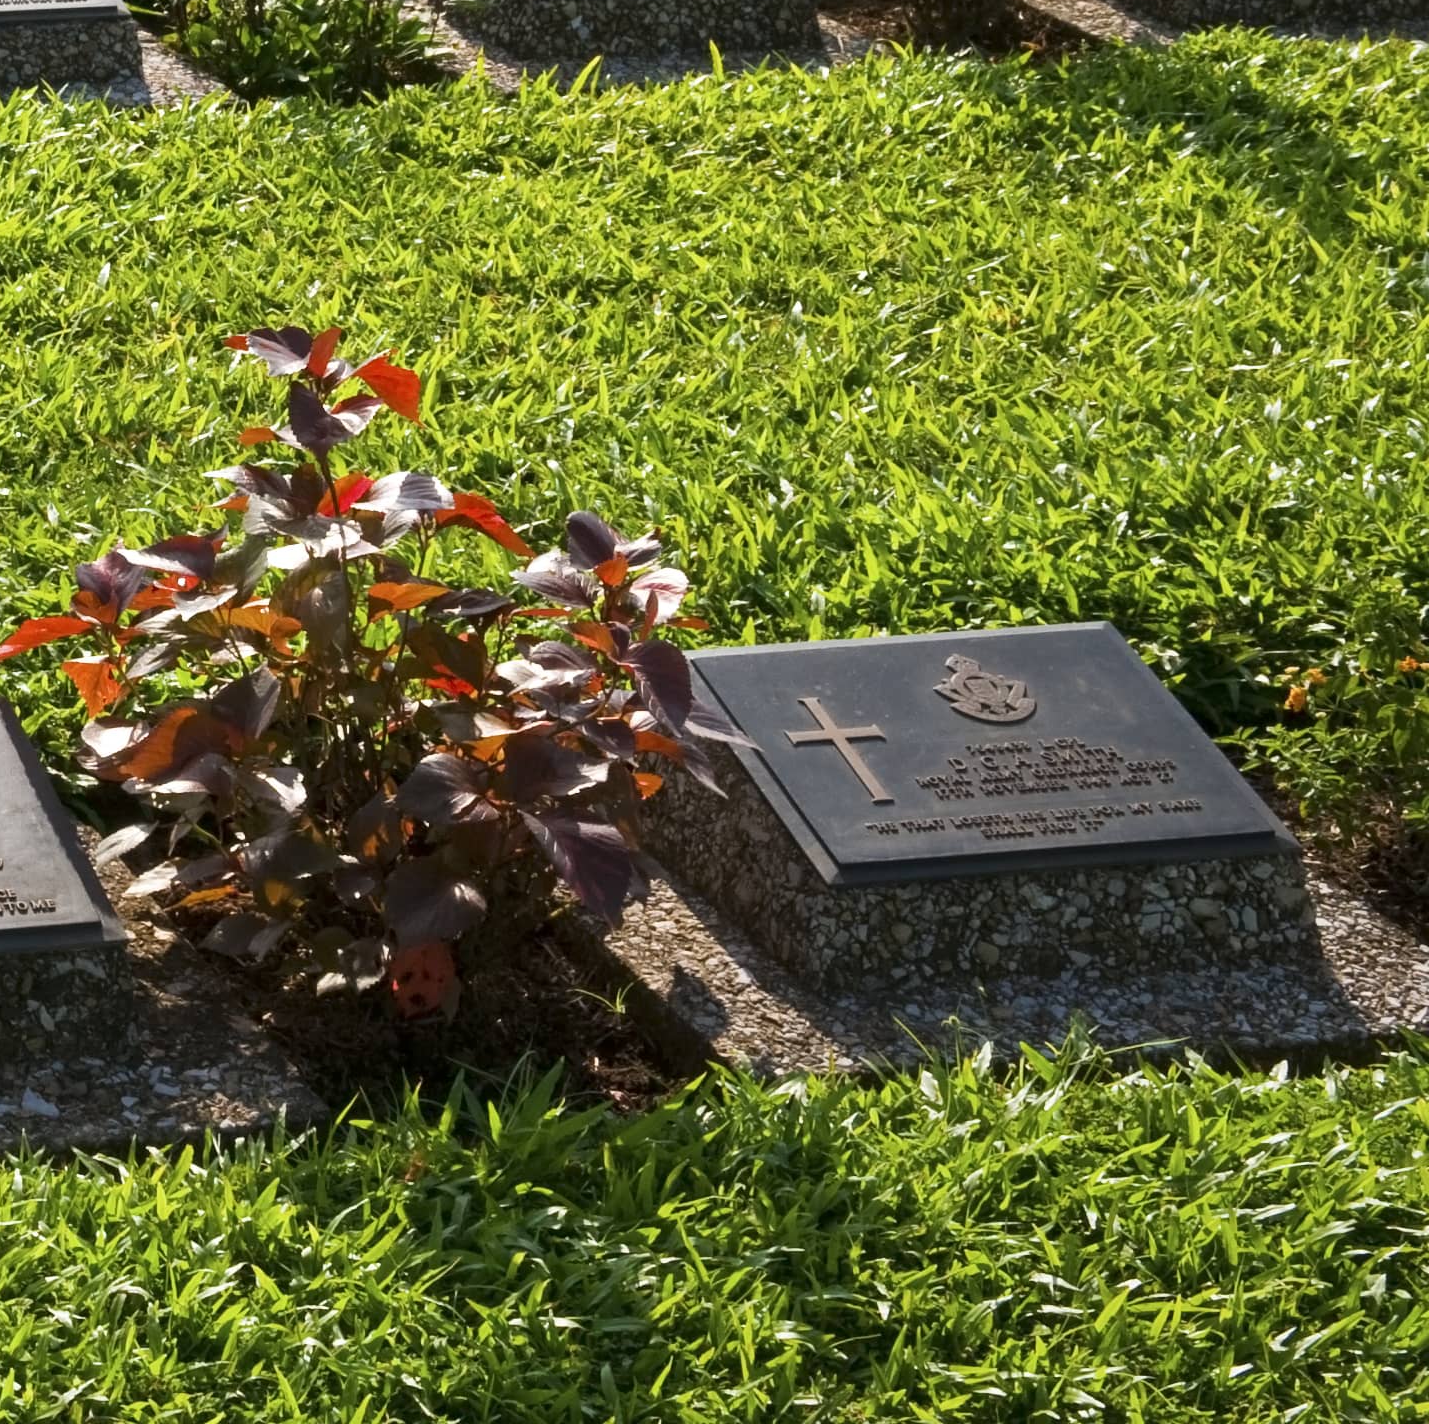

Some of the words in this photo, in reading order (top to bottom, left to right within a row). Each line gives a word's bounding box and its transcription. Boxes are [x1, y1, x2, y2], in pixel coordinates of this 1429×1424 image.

[1040, 746, 1124, 767] SMITH
[916, 775, 973, 789] ROYAL
[980, 770, 1023, 784] ARMY
[1031, 762, 1120, 779] ORDNANCE
[1125, 758, 1178, 773] CORPS
[979, 779, 1071, 797] NOVEMBER
[1120, 773, 1153, 787] AGE
[901, 817, 946, 833] THAT
[951, 813, 1014, 830] LOSETH
[1016, 810, 1047, 825] HIS
[1050, 807, 1087, 821] LIFE
[1089, 805, 1125, 819] FOR
[1127, 801, 1154, 816] MY
[1158, 798, 1203, 813] SAKE
[981, 825, 1034, 840] SHALL
[1035, 822, 1078, 837] FIND
[4, 900, 29, 917] TO
[30, 897, 57, 914] ME
